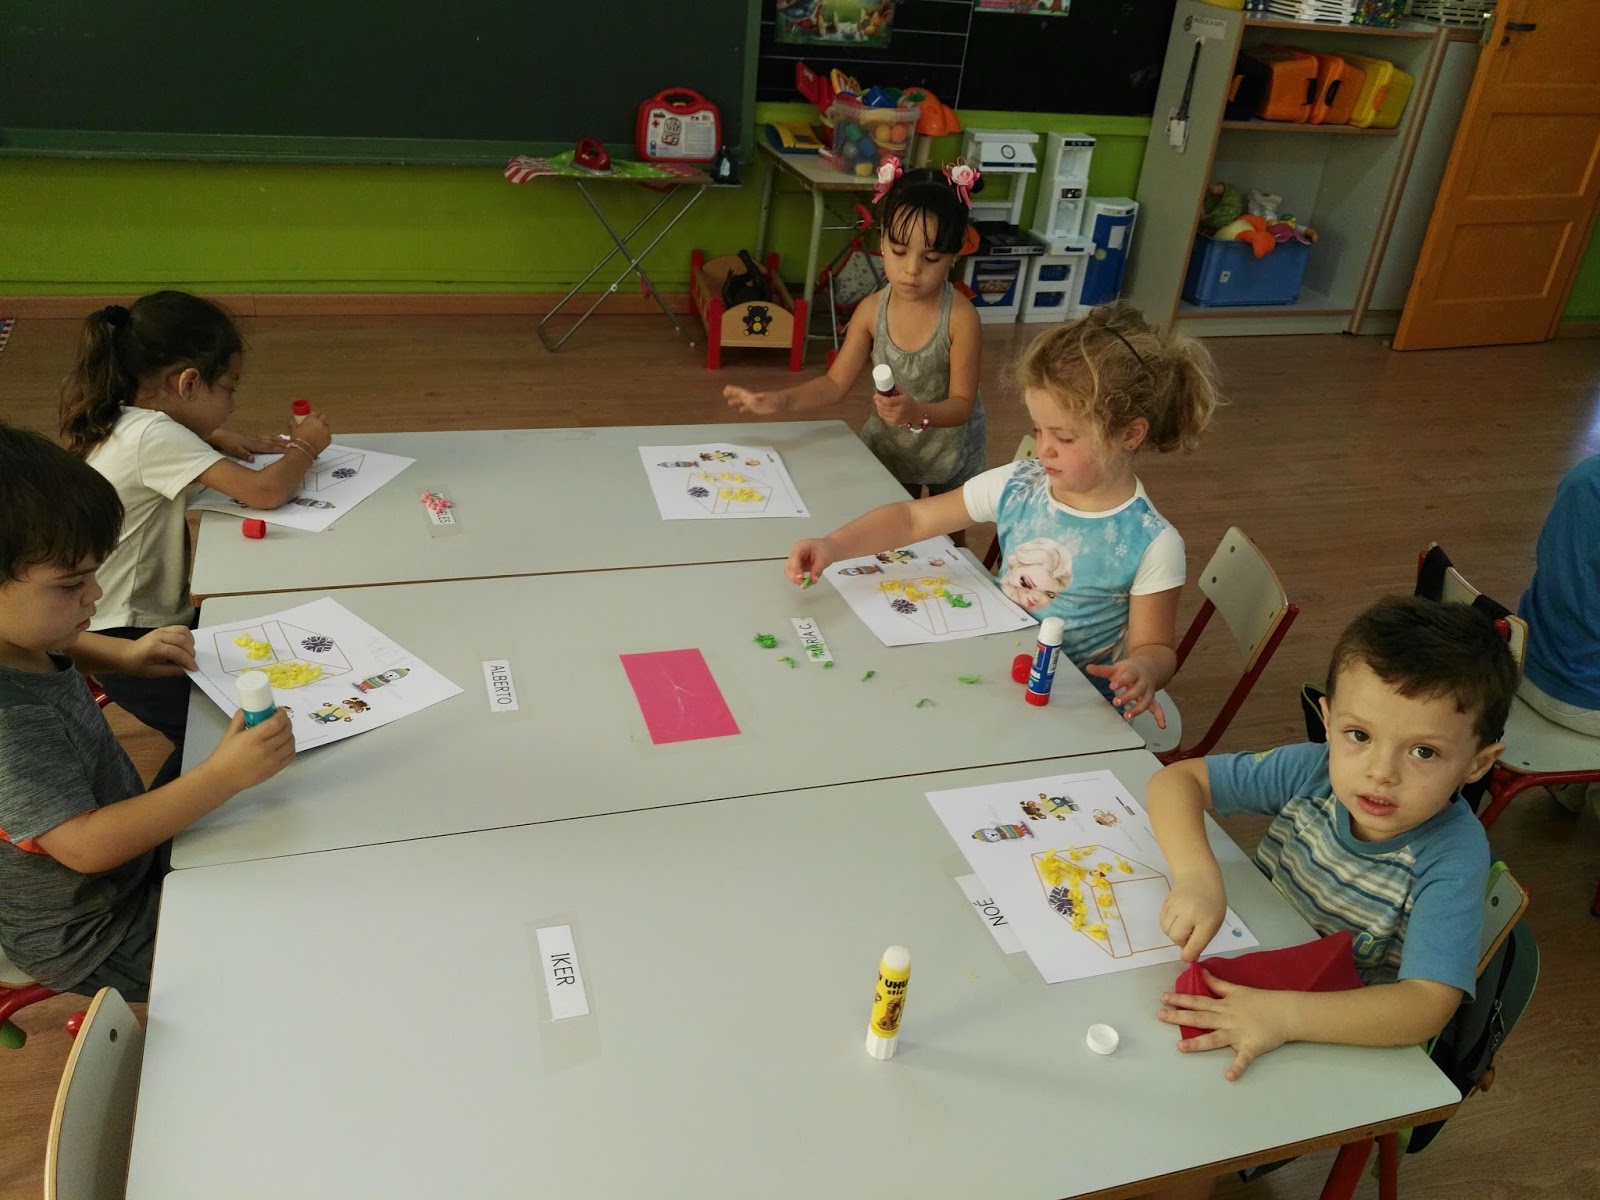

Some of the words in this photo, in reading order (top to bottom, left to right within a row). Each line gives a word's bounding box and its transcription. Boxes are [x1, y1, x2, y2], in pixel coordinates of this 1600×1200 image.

[490, 665, 512, 705] ALBERTO
[973, 898, 1008, 927] NOÉ
[550, 952, 576, 987] IKER
[884, 978, 910, 989] UHU
